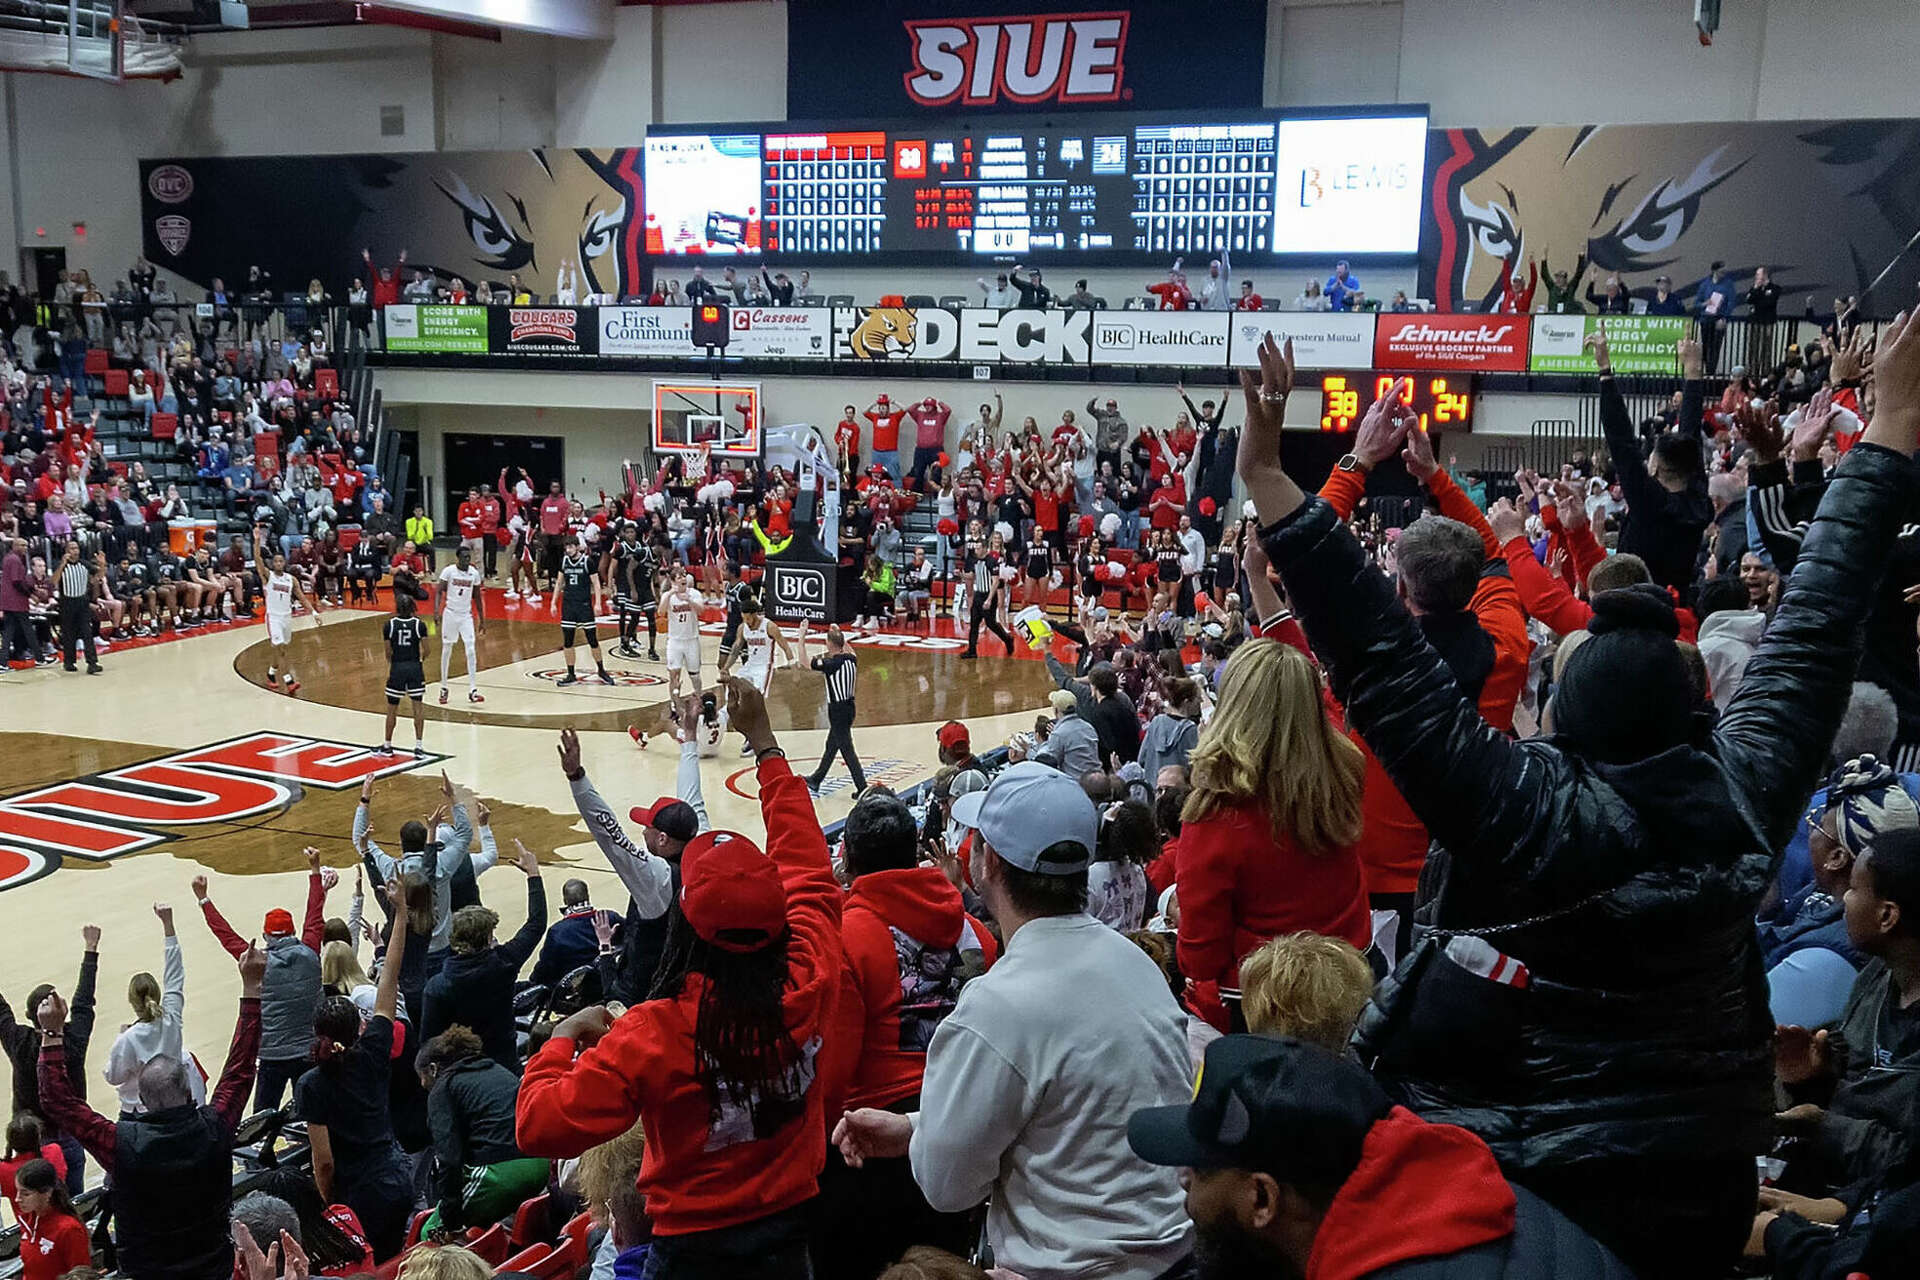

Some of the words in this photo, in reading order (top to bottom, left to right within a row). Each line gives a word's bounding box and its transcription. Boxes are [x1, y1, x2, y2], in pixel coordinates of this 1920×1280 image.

[905, 14, 1127, 102] SIUE
[456, 307, 481, 316] WITH
[511, 310, 576, 324] COUGARS
[622, 311, 660, 328] First
[752, 309, 809, 325] Cassens
[605, 320, 692, 341] Communi
[1646, 319, 1684, 330] WITH
[912, 308, 1090, 362] DECK
[1102, 330, 1130, 347] BJC
[1138, 330, 1225, 346] HealthCare
[1326, 332, 1361, 343] Mutual
[1389, 324, 1514, 343] Schnucks
[764, 345, 786, 355] Jeep
[1389, 343, 1434, 353] EXCLUSIVE
[1434, 344, 1475, 353] GROCERY
[1475, 344, 1514, 354] PARTNER
[1424, 352, 1437, 360] the
[1455, 352, 1486, 361] Cougars
[975, 368, 989, 378] 107
[1329, 391, 1359, 418] 38
[1435, 393, 1468, 421] 24
[569, 574, 579, 585] 21
[781, 575, 819, 600] BJC
[775, 605, 825, 619] HealthCare
[398, 629, 412, 646] 12
[708, 729, 720, 745] 3
